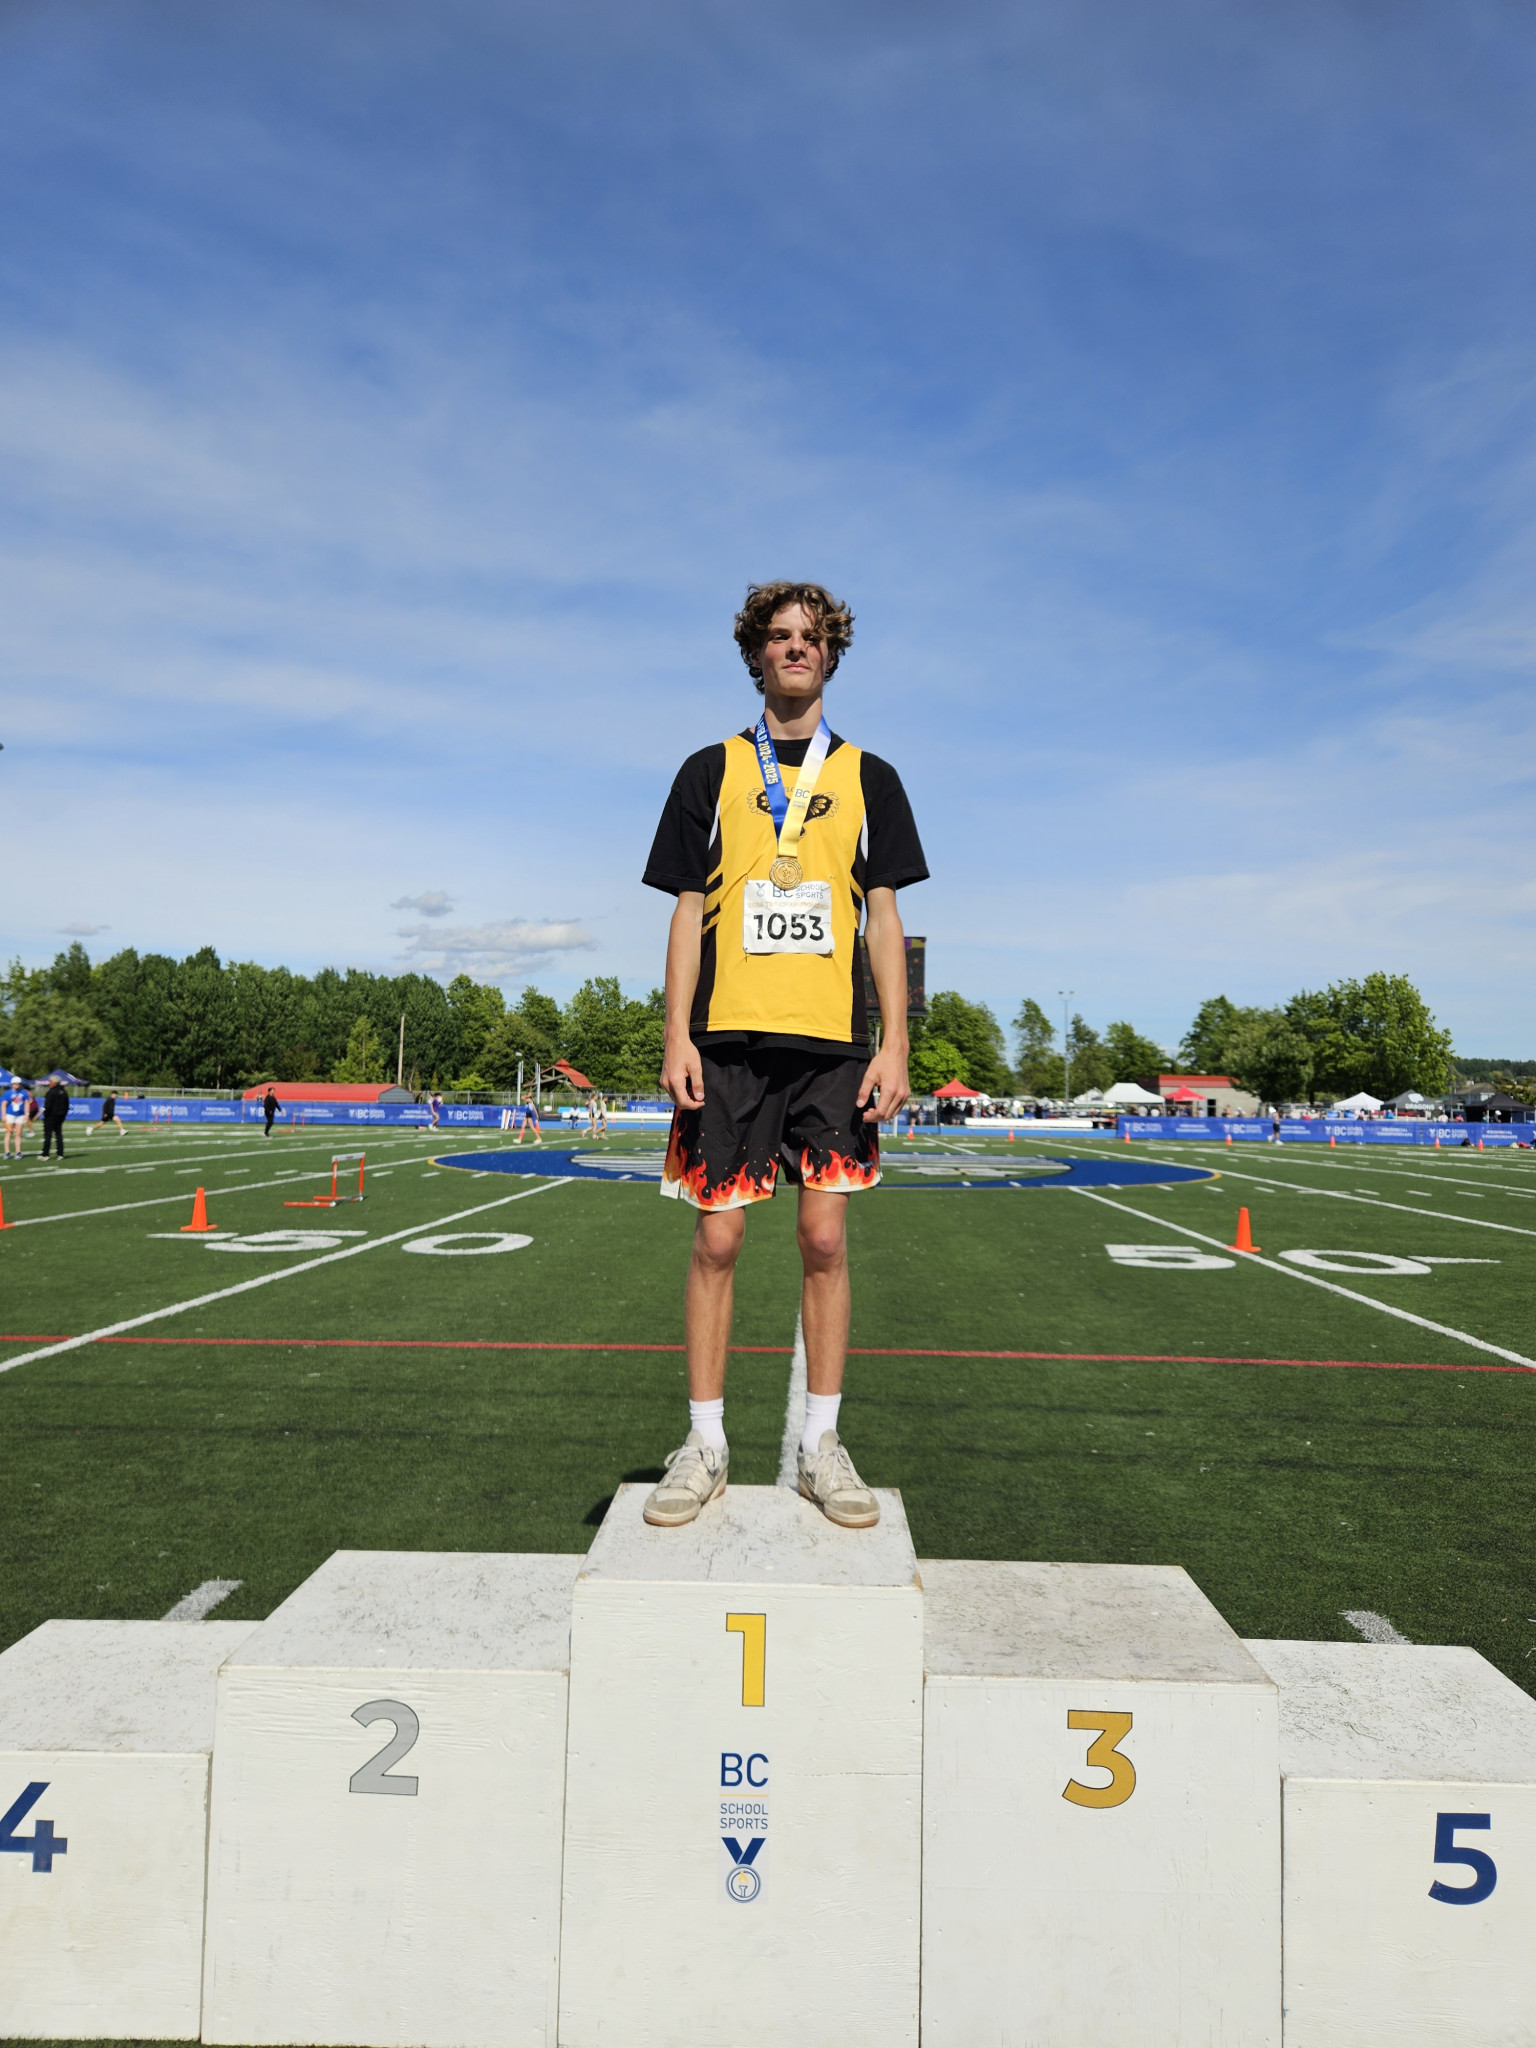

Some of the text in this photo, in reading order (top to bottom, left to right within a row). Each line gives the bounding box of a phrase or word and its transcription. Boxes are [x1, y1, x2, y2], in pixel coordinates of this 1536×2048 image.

[758, 741, 779, 785] 2024-2025
[794, 788, 810, 798] BC
[772, 884, 793, 898] BC
[796, 883, 824, 892] SCHOOL
[796, 891, 824, 899] SPORTS
[753, 913, 824, 941] 1053
[1405, 1103, 1435, 1111] DRAGONS
[357, 1109, 369, 1119] BC
[456, 1110, 468, 1121] BC
[1132, 1123, 1145, 1133] BC
[1233, 1124, 1245, 1134] BC
[1334, 1126, 1346, 1136] BC
[1438, 1128, 1451, 1139] BC
[726, 1612, 766, 1707] 1
[349, 1698, 420, 1796] 2
[1061, 1709, 1137, 1809] 3
[720, 1752, 769, 1788] BC
[720, 1803, 769, 1815] SCHOOL
[0, 1781, 68, 1873] 4
[720, 1817, 769, 1830] SPORTS
[1428, 1812, 1498, 1905] 5
